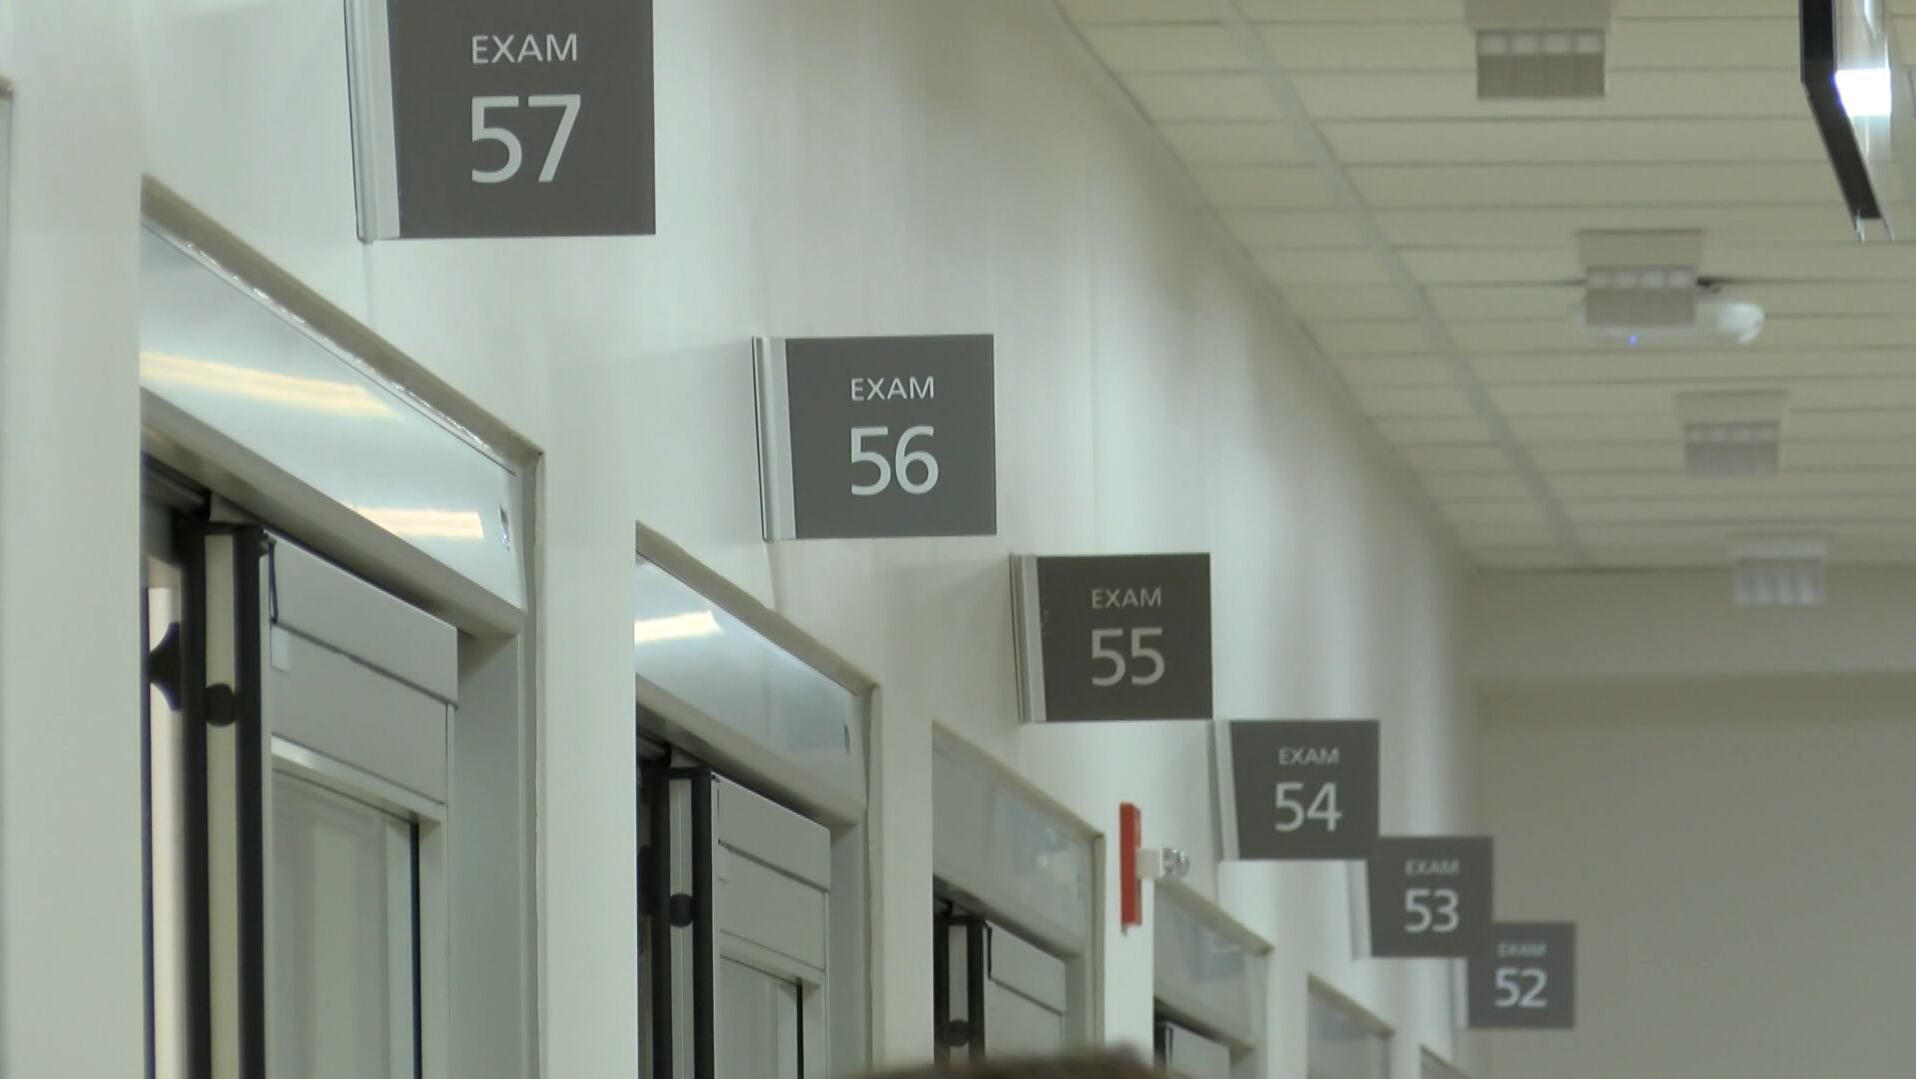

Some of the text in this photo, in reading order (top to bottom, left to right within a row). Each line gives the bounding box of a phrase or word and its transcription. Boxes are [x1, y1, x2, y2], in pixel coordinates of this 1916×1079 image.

[472, 33, 577, 64] EXAM
[471, 94, 581, 184] 57
[851, 375, 934, 401] EXAM
[850, 425, 939, 496] 56
[1091, 587, 1162, 609] EXAM
[1091, 627, 1165, 687] 55
[1279, 747, 1340, 765] EXAM
[1275, 782, 1342, 832] 54
[1405, 888, 1459, 933] 53
[1496, 967, 1547, 1008] 52
